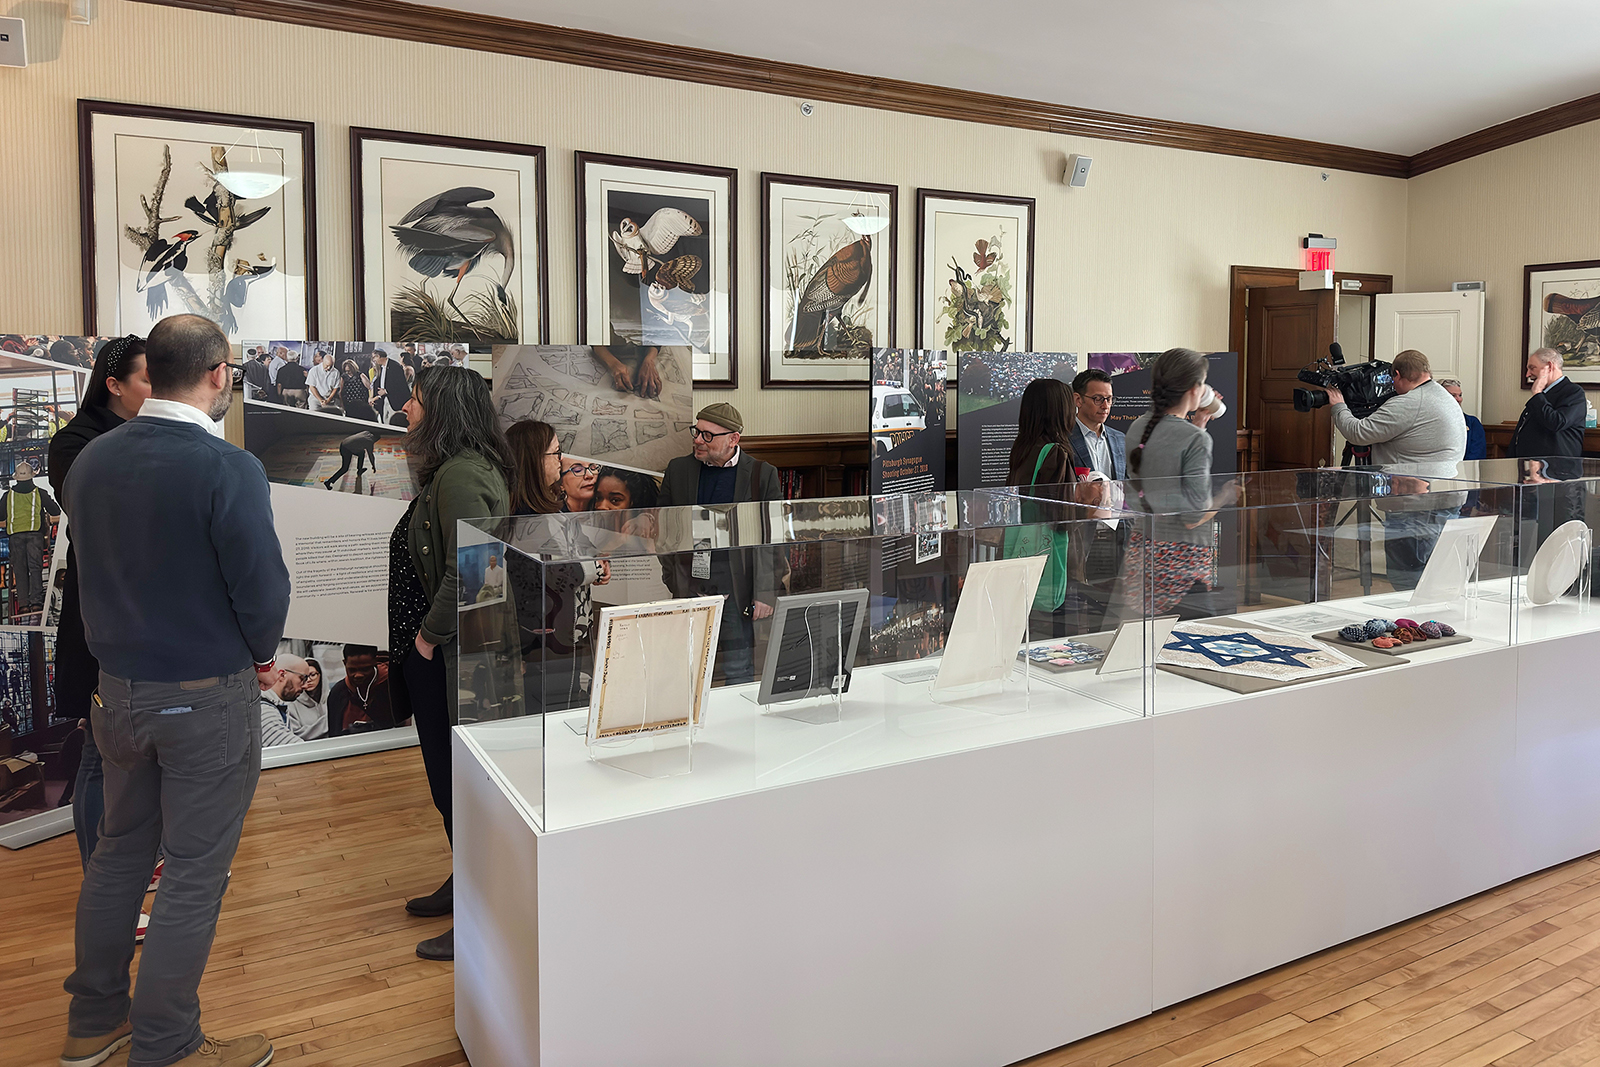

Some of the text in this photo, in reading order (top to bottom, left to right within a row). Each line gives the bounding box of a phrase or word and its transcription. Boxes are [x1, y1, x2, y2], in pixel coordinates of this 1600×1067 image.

[1311, 251, 1331, 272] EXIT
[882, 457, 922, 468] Pittsburgh Synagogue
[882, 469, 899, 479] Shooting
[900, 467, 914, 476] October
